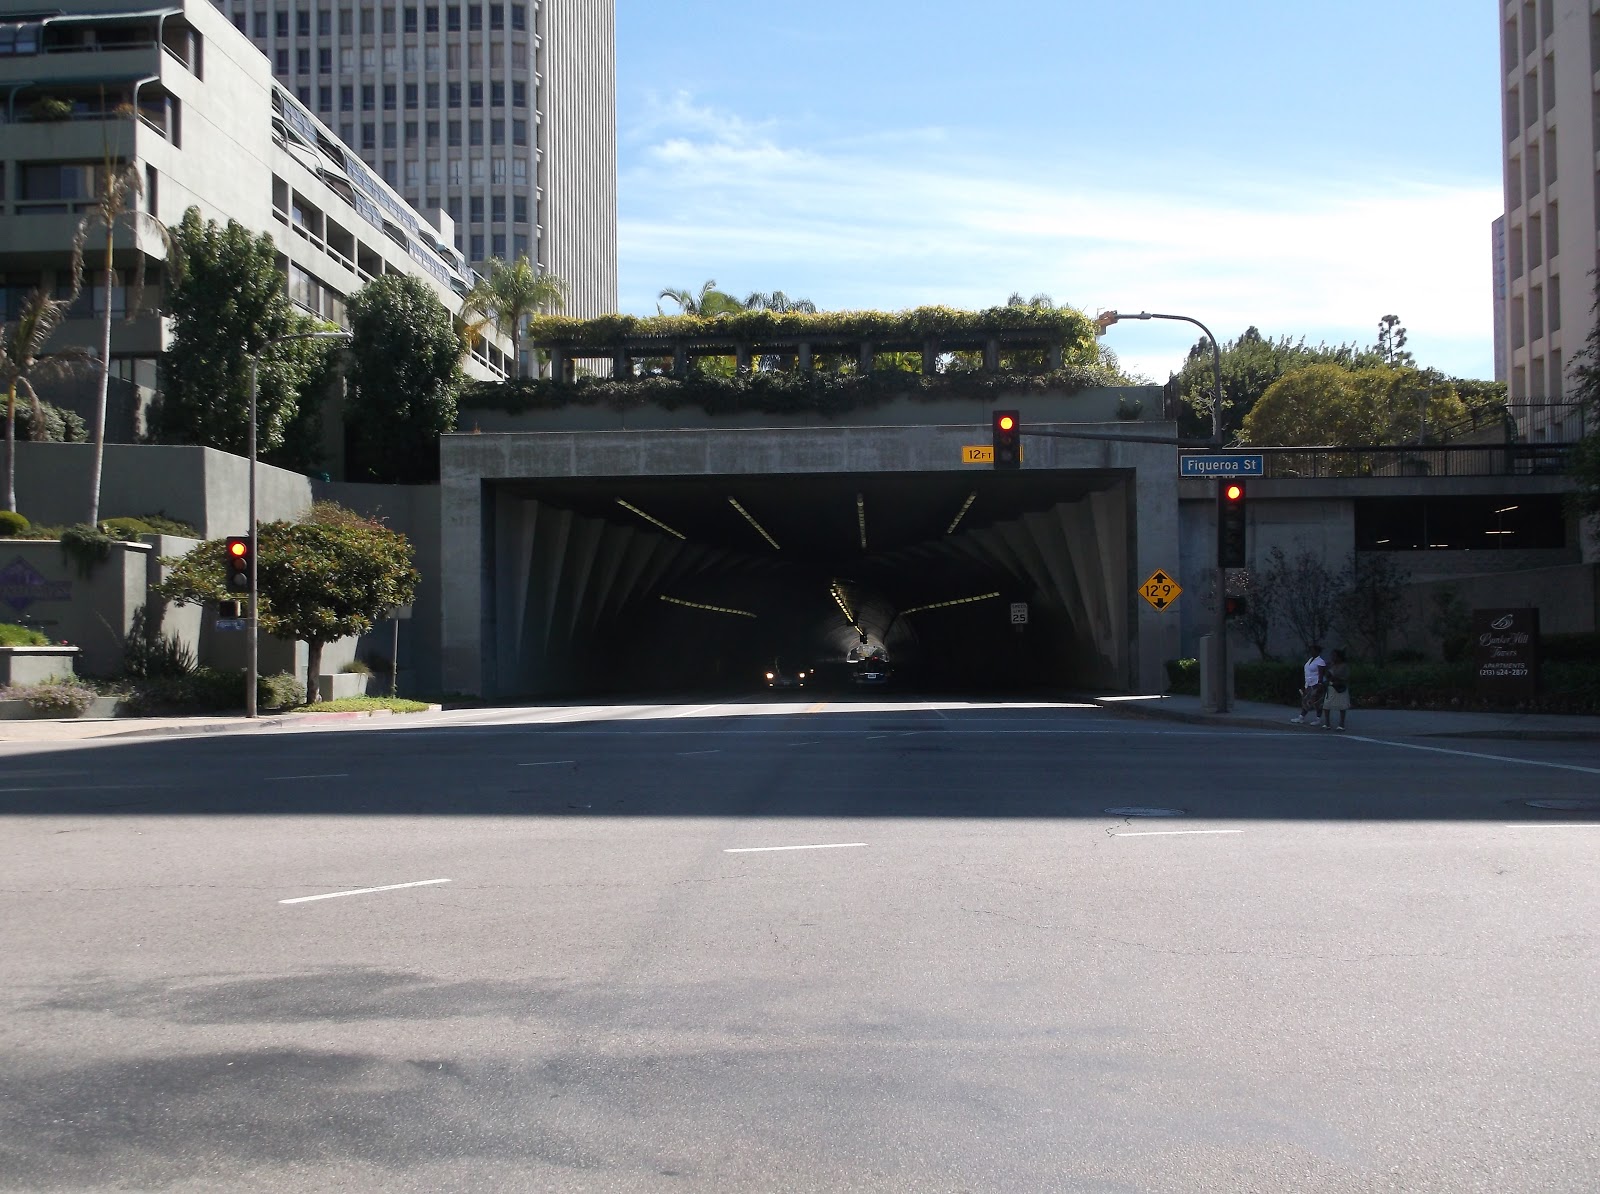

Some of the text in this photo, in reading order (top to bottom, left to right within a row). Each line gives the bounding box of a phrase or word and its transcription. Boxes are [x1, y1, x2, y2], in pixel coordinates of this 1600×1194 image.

[1188, 460, 1256, 473] Figueroa St
[1013, 614, 1026, 622] 25
